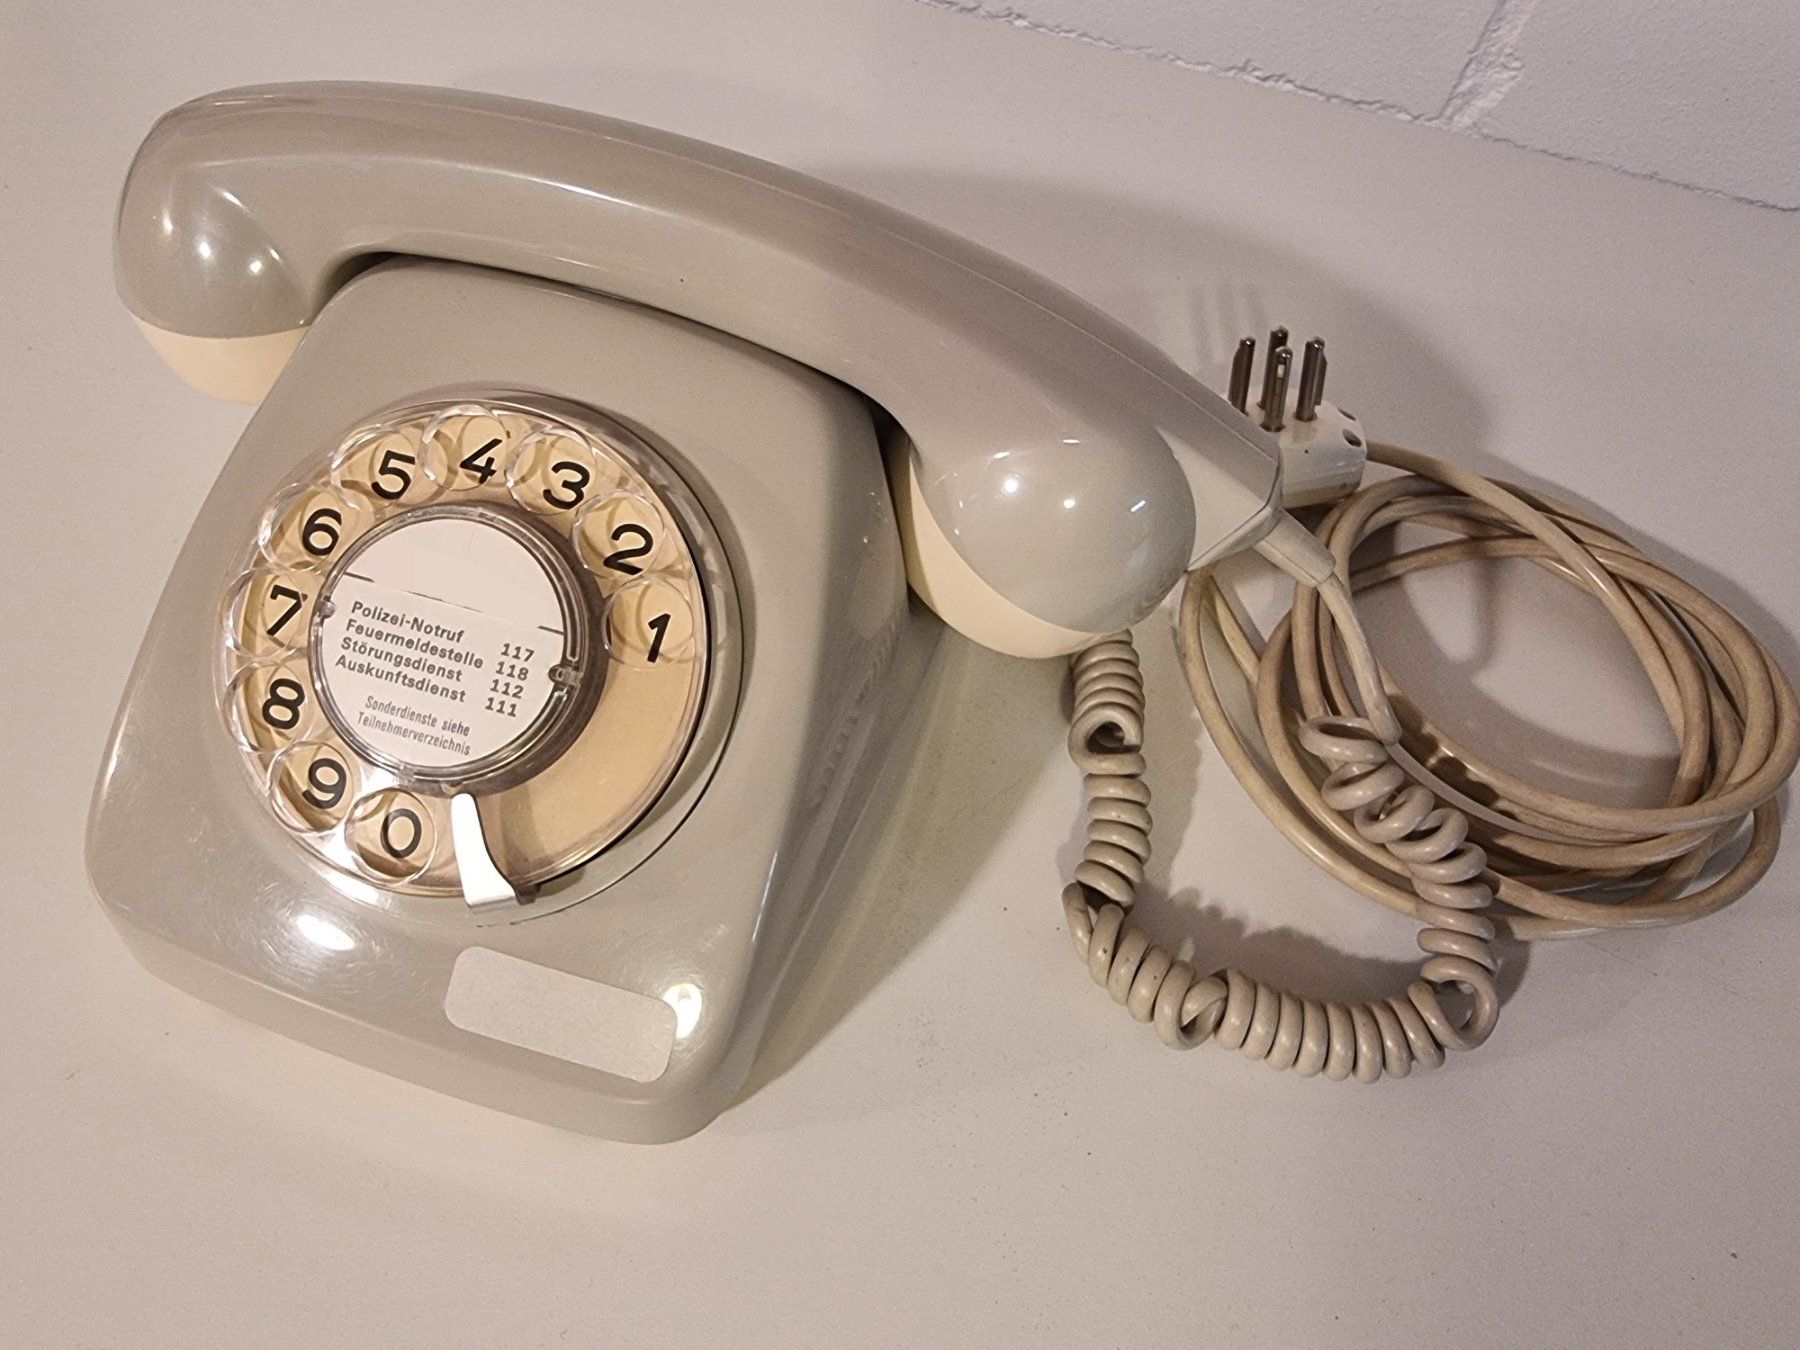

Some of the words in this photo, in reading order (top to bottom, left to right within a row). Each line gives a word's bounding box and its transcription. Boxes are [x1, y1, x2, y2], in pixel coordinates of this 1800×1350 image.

[371, 450, 415, 499] 5
[459, 438, 503, 484] 4
[542, 461, 591, 509] 3
[301, 508, 343, 556] 6
[603, 523, 653, 575] 2
[267, 584, 308, 636] 7
[351, 600, 465, 644] Polizei-Notruf
[500, 642, 534, 663] 117
[345, 618, 484, 669] Feuermeldestelle
[495, 661, 529, 681] 118
[645, 612, 671, 663] 1
[335, 654, 466, 703] Auskunftsdienst
[485, 697, 518, 718] 111
[340, 636, 463, 682] Störungsdienst
[489, 678, 524, 699] 112
[262, 677, 306, 730] 8
[364, 695, 438, 728] Sonderdienste
[441, 717, 471, 737] siehe
[356, 711, 471, 756] Teilnehmerverzeichnis
[301, 757, 347, 809] 9
[380, 808, 422, 858] 0
